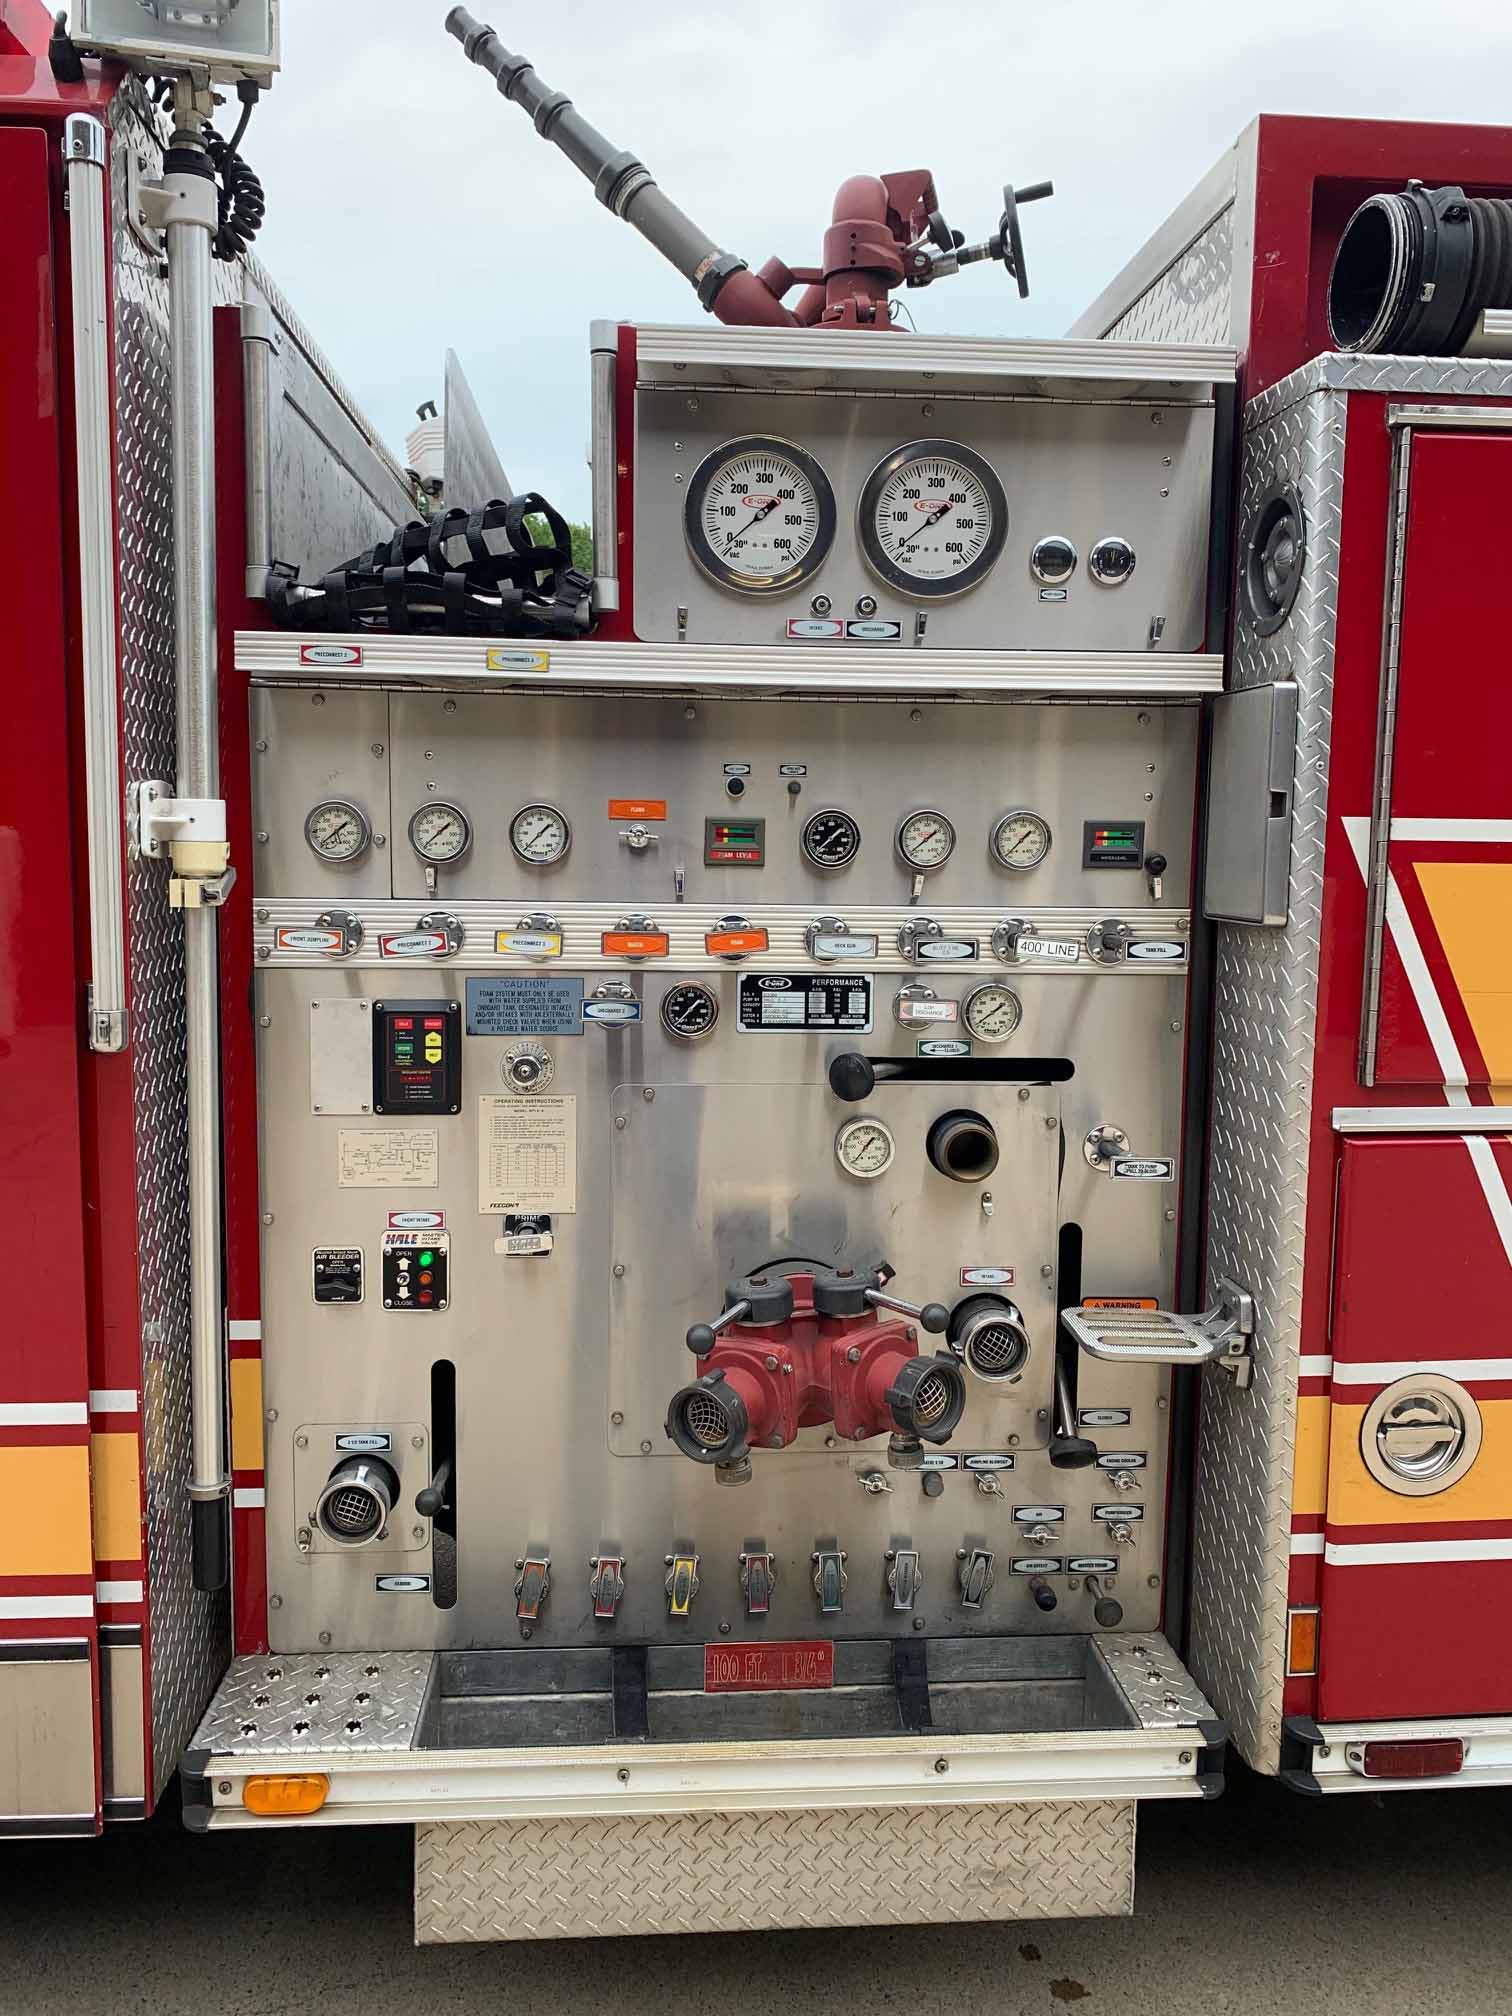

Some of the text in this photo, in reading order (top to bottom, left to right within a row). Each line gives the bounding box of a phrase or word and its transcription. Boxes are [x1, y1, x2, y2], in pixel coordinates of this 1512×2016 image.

[756, 473, 774, 484] 300
[928, 478, 945, 488] 300
[731, 484, 748, 494] 200
[777, 489, 795, 500] 400
[903, 489, 920, 499] 200
[949, 493, 967, 503] 400
[720, 506, 736, 517] 100
[892, 511, 908, 522] 100
[785, 515, 802, 525] 500
[956, 519, 973, 529] 500
[727, 532, 733, 543] 0
[899, 537, 905, 547] 0
[774, 538, 791, 549] 600
[946, 542, 963, 553] 600
[730, 551, 740, 559] VAC
[1020, 941, 1076, 957] 400' LINE
[385, 1233, 418, 1245] HALE
[713, 1654, 739, 1683] 100
[744, 1653, 768, 1682] FT.
